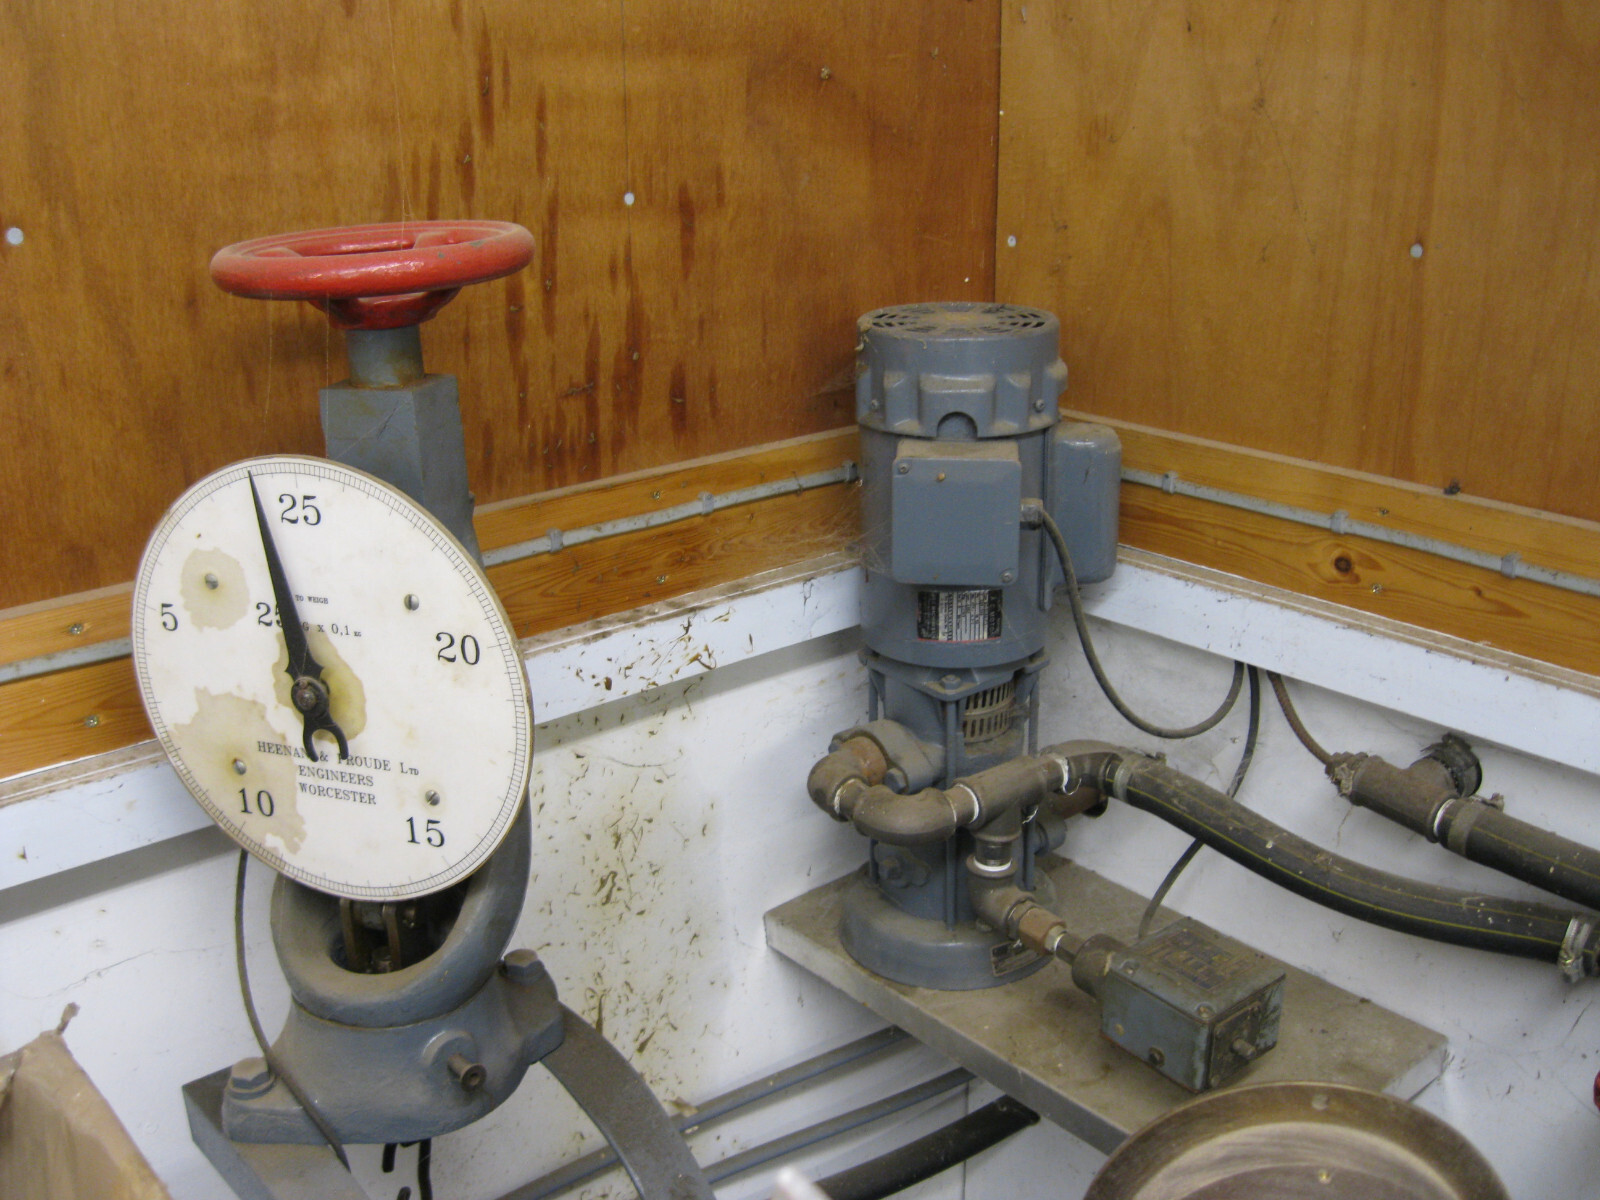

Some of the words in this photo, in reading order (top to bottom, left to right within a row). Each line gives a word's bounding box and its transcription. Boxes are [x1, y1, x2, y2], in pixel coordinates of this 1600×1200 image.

[278, 492, 322, 527] 25
[308, 596, 329, 604] WEIGH
[160, 602, 180, 632] 5
[435, 631, 481, 667] 20
[319, 750, 329, 762] &
[298, 764, 374, 787] ENGINEERS
[238, 787, 275, 818] 10
[298, 782, 377, 805] WORCESTER
[406, 816, 446, 849] 15
